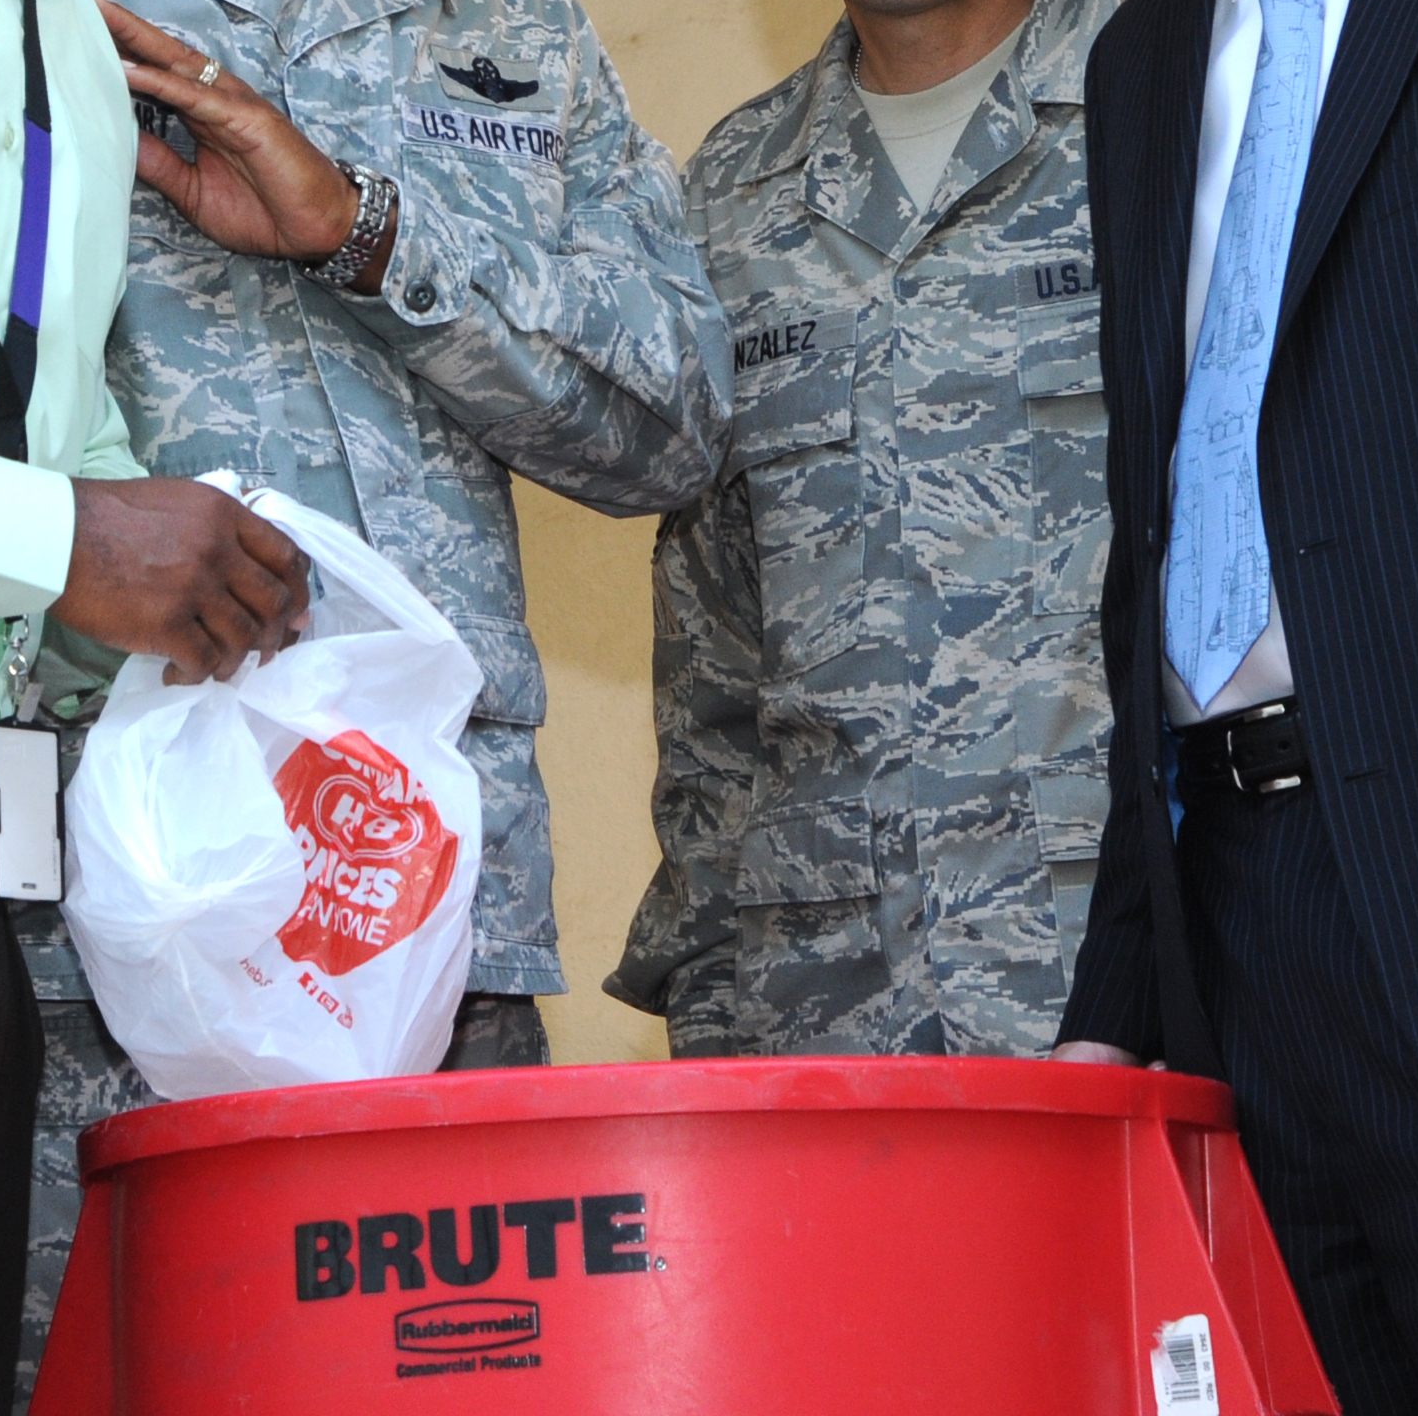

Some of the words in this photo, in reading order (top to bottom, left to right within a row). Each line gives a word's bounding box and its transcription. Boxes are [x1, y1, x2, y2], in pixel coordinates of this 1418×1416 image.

[420, 109, 465, 143] U.S.
[469, 117, 511, 151] AIR
[294, 1192, 650, 1302] BRUTE
[401, 1313, 535, 1341] Rubbermaid
[396, 1356, 476, 1378] Commercial
[480, 1351, 542, 1371] Products
